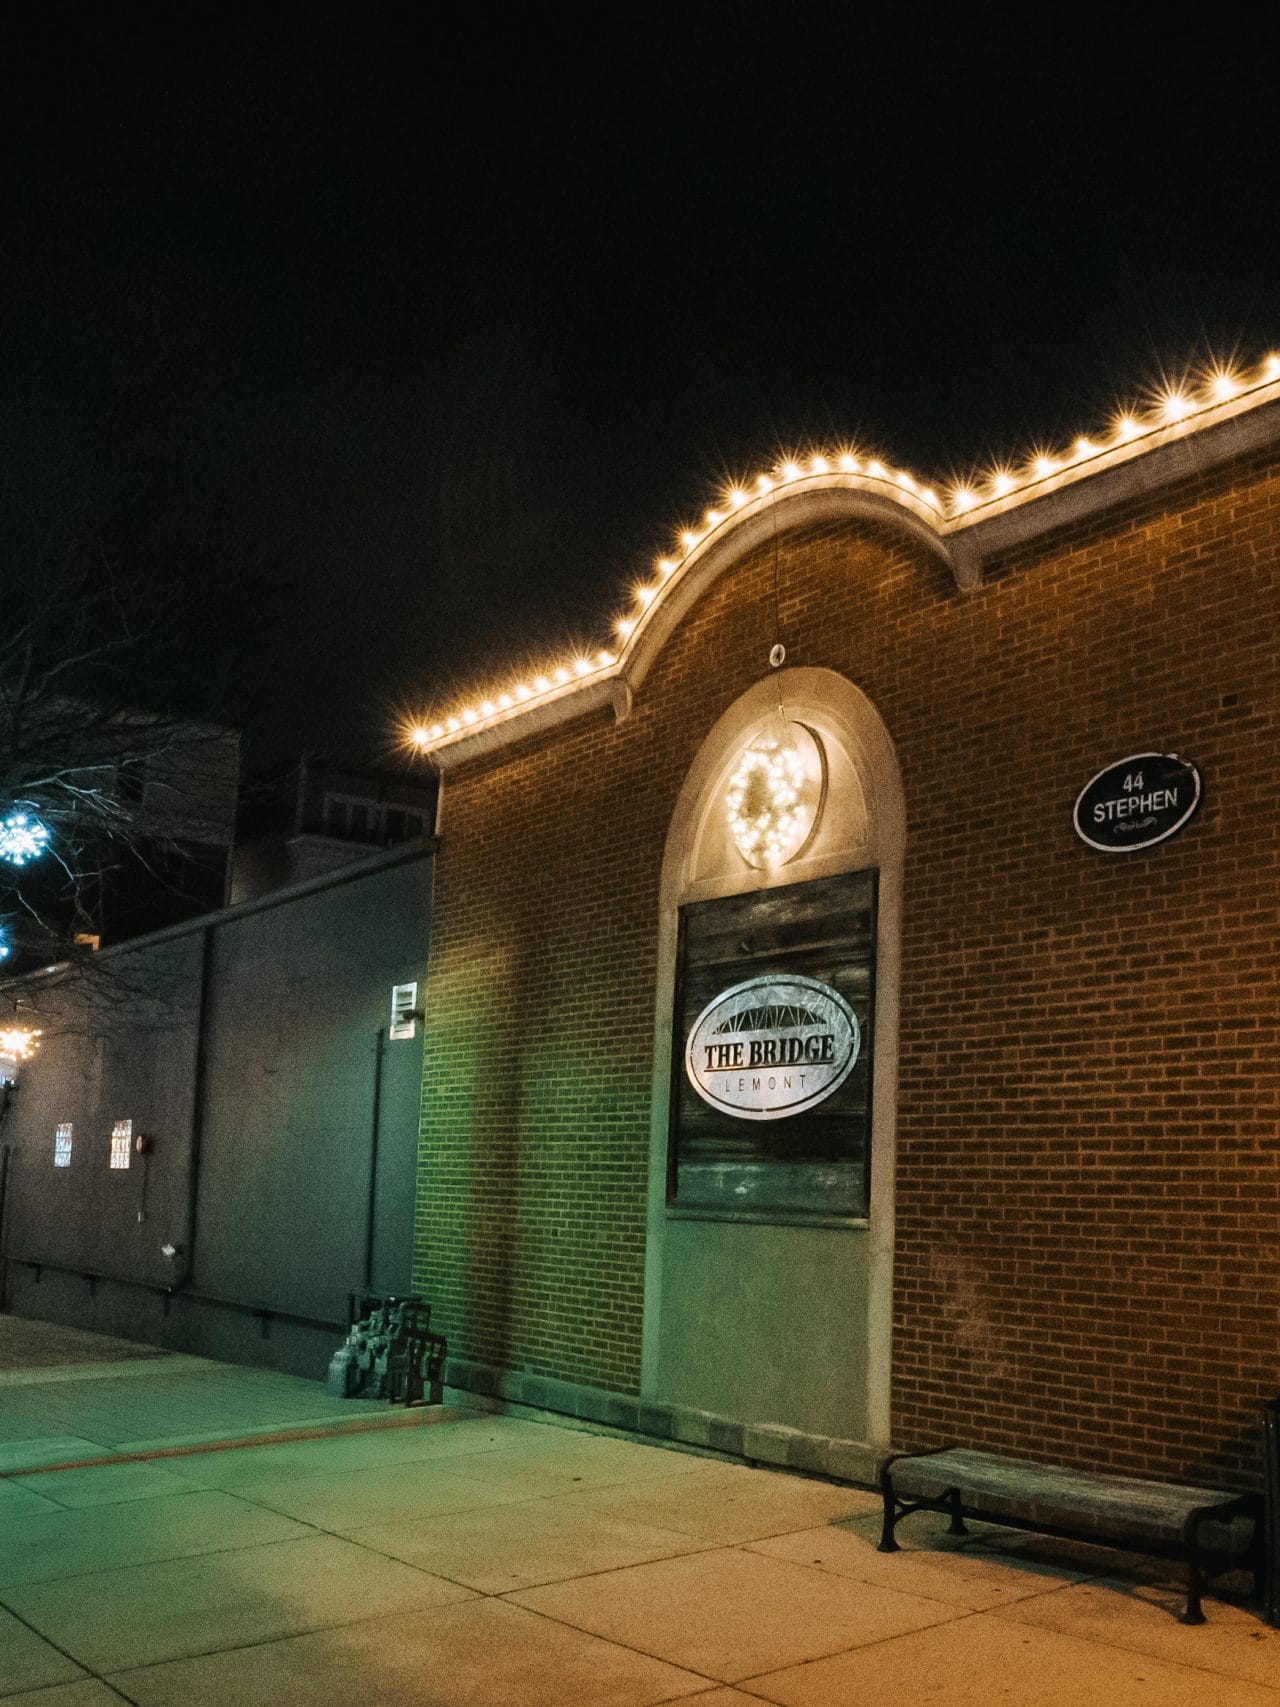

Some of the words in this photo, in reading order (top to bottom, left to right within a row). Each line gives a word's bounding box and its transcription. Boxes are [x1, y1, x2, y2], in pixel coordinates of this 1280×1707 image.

[1123, 771, 1144, 792] 44
[1093, 787, 1178, 823] STEPHEN
[704, 1042, 744, 1069] THE
[749, 1034, 835, 1066] BRIDGE
[725, 1074, 807, 1093] LEMONT
